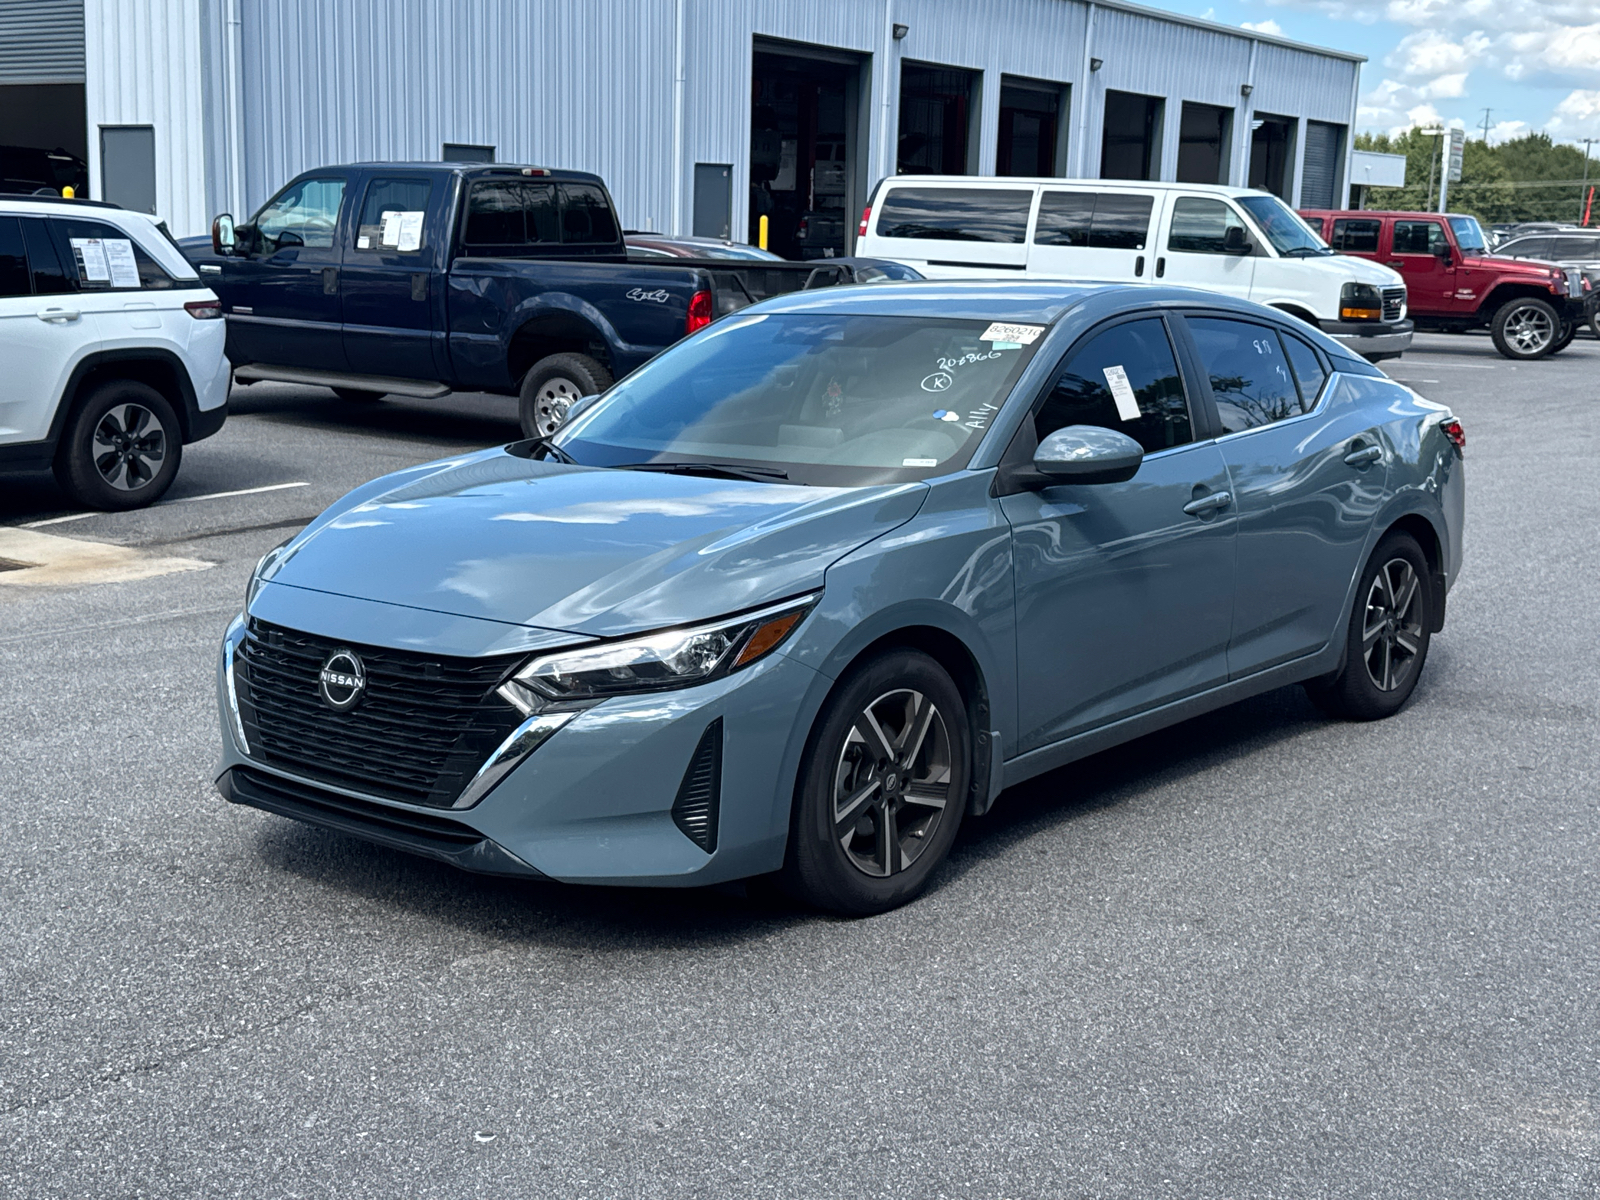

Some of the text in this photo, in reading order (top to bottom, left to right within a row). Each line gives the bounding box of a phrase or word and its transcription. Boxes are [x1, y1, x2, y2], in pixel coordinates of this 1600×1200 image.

[626, 288, 670, 303] 4x4
[965, 402, 998, 428] Ally
[320, 670, 364, 688] NISSAN
